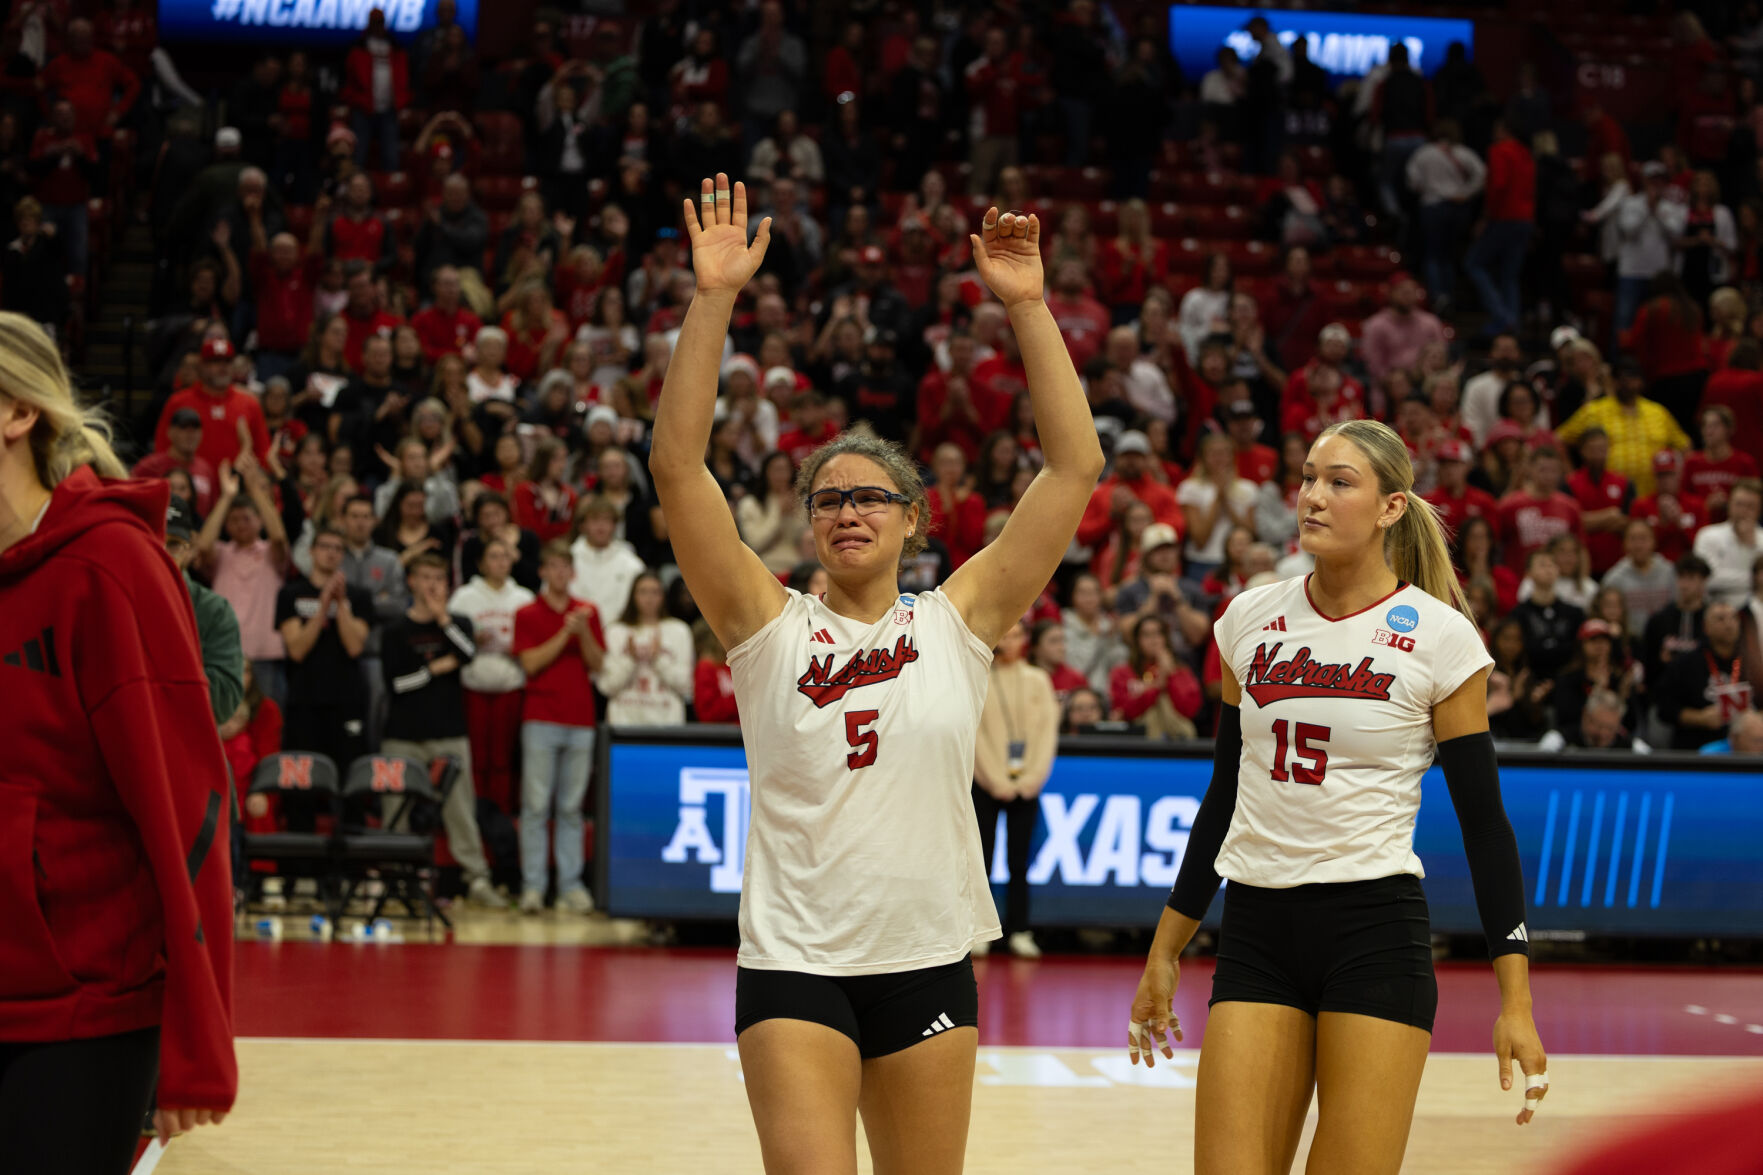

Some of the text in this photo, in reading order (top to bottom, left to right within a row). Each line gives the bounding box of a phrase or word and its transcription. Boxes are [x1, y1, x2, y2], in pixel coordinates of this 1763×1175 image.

[797, 633, 919, 687] Nebask
[1246, 642, 1396, 697] Nebraska
[844, 709, 879, 771] 5
[1270, 718, 1331, 786] 15
[279, 755, 313, 790] N
[371, 757, 406, 792] N
[990, 793, 1201, 888] XAS
